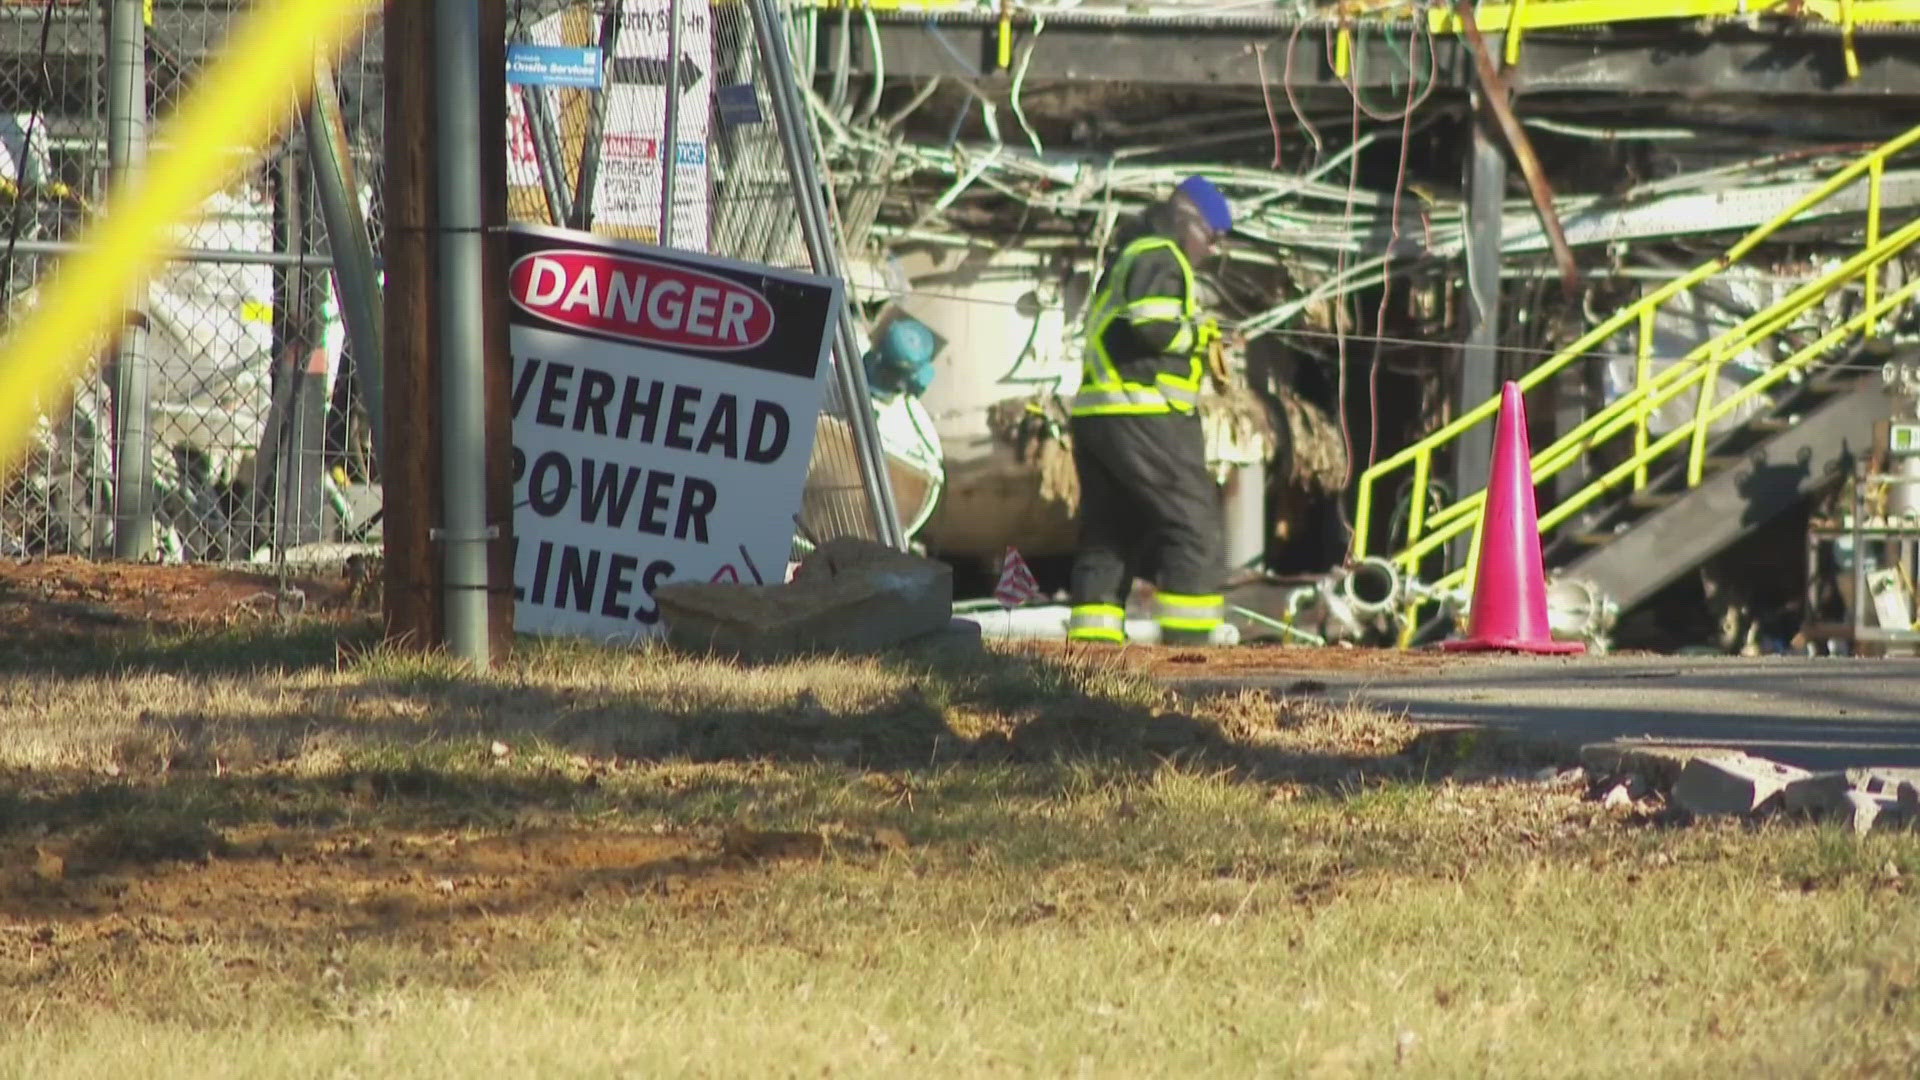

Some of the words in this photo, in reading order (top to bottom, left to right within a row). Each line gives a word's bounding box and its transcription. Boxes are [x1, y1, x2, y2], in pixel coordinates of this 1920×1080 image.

[622, 9, 653, 36] urity
[524, 256, 754, 344] DANGER
[512, 356, 791, 466] VERHEAD
